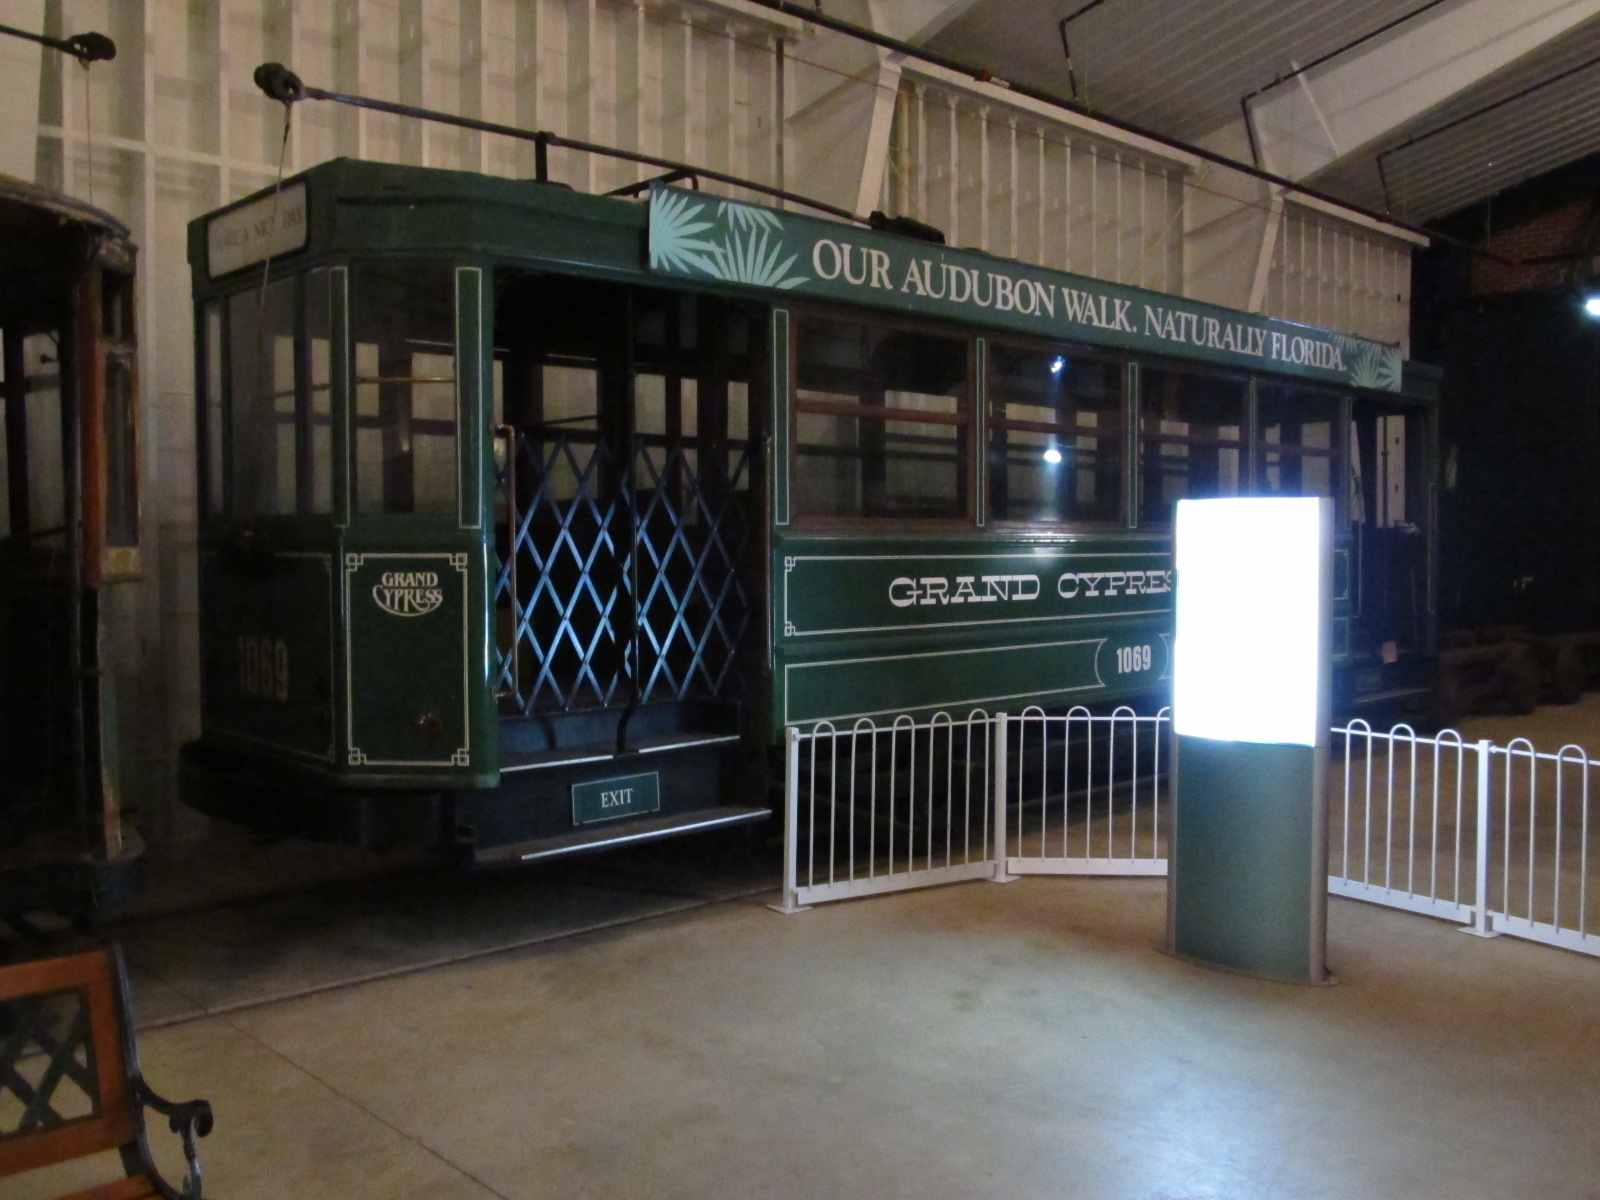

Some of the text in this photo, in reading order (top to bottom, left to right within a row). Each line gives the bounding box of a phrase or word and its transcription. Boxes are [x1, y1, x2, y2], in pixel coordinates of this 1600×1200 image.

[812, 239, 893, 290] OUR
[900, 257, 1055, 318] AUDUBON
[1061, 287, 1137, 332] WALK.
[1144, 304, 1267, 357] NATURALLY
[382, 571, 439, 588] GRAND
[888, 574, 1041, 608] GRAND
[372, 584, 444, 617] CYPRESS
[236, 634, 289, 704] 1069
[1116, 645, 1152, 675] 1069
[601, 787, 634, 809] EXIT
